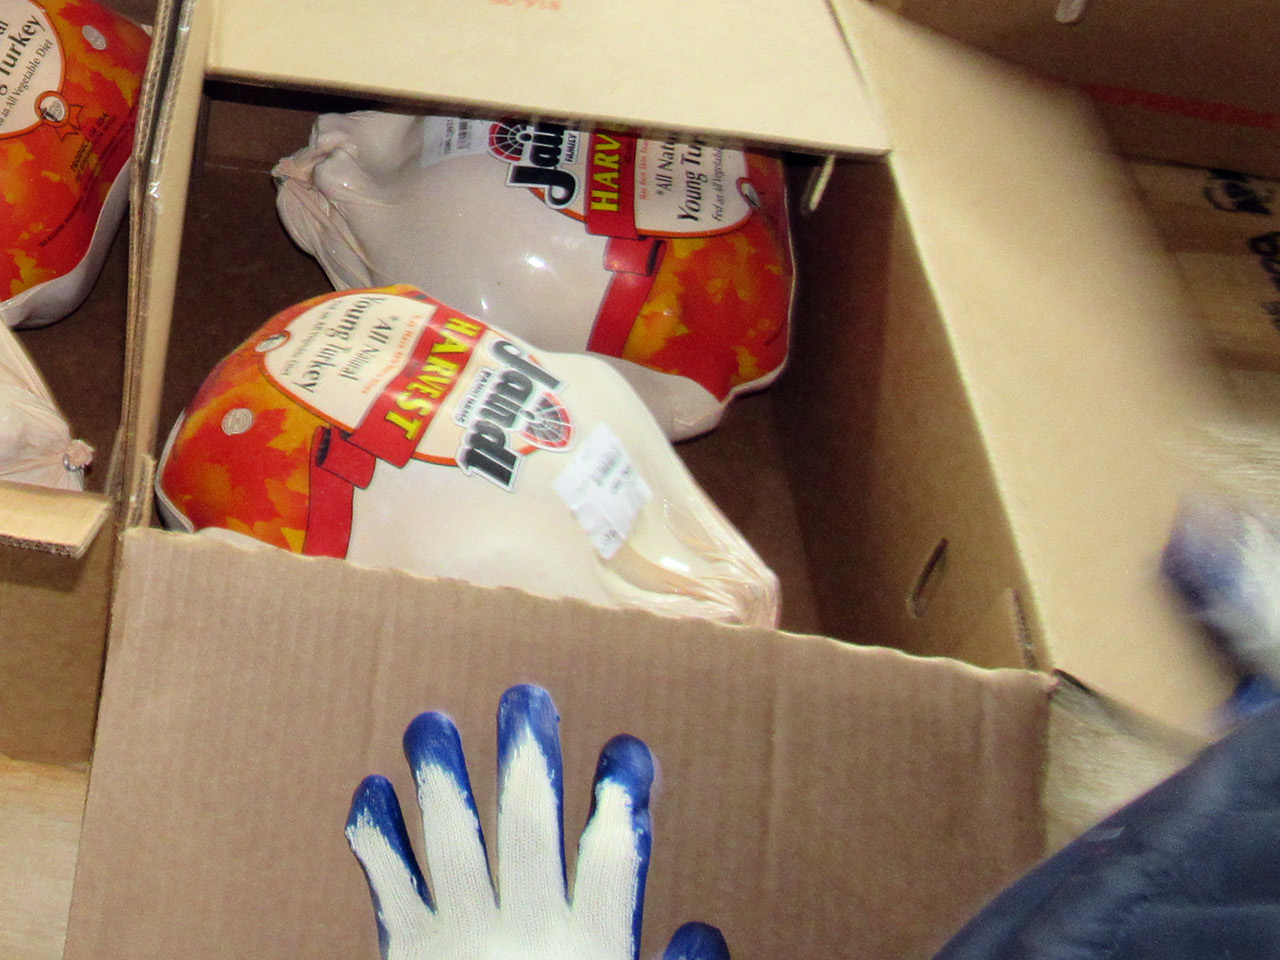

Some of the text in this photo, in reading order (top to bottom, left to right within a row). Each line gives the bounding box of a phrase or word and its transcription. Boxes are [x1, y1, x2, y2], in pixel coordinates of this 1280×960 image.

[4, 94, 17, 108] All
[11, 57, 41, 96] Vegetable
[35, 38, 53, 57] Diet
[565, 133, 576, 161] FAMILY
[591, 133, 622, 210] HARV
[678, 171, 706, 220] Young
[713, 206, 721, 221] Fed
[292, 294, 385, 393] Young Turkey
[338, 343, 379, 381] Natural
[385, 317, 481, 440] HARVEST
[464, 340, 558, 487] Jaindl
